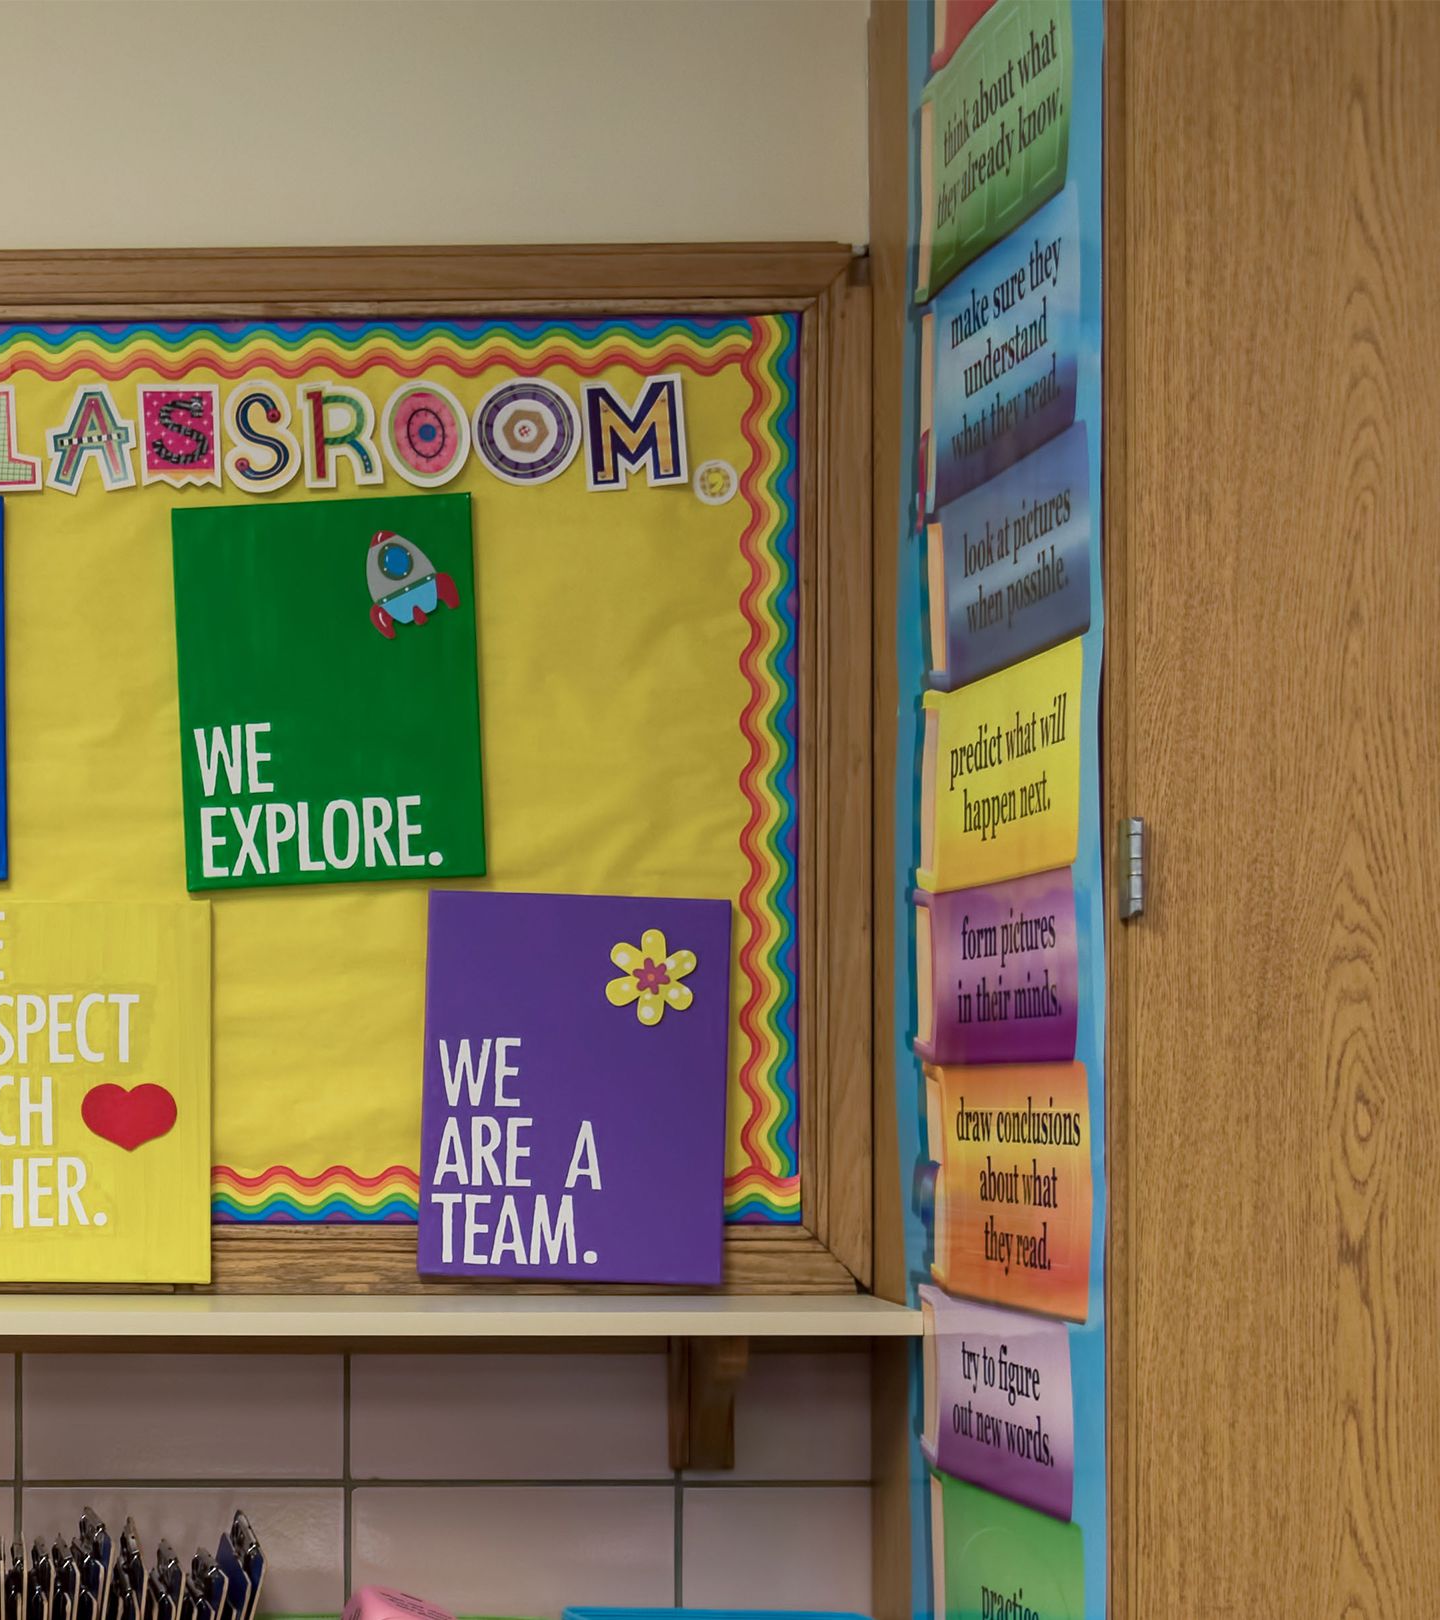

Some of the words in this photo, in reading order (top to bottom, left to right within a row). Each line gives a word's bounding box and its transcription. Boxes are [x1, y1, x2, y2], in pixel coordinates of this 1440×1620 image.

[943, 99, 970, 168] think
[972, 78, 1015, 132] about
[1018, 19, 1057, 88] what
[936, 180, 960, 229] they
[961, 121, 1015, 202] already
[1018, 86, 1063, 153] know.
[951, 288, 989, 350] make
[992, 267, 1025, 319] sure
[1029, 237, 1062, 291] they
[963, 295, 1048, 399] understand
[951, 414, 987, 462] what
[990, 391, 1020, 437] they
[1024, 352, 1060, 419] read.
[964, 521, 994, 578] look
[997, 517, 1010, 561] at
[1013, 489, 1071, 564] pictures
[966, 584, 1003, 633] when
[1007, 545, 1069, 629] possible.
[193, 721, 275, 796] WE
[949, 723, 1002, 791] predict
[1005, 710, 1036, 761] what
[1040, 692, 1067, 748] will
[199, 794, 444, 879] EXPLORE.
[963, 788, 1016, 841] happen
[1019, 769, 1051, 819] next.
[961, 915, 997, 960] form
[1000, 907, 1056, 968] pictures
[957, 979, 972, 1023] in
[976, 975, 1011, 1022] their
[1014, 968, 1062, 1019] minds.
[439, 1037, 521, 1107] WE
[433, 1116, 533, 1187] ARE
[564, 1120, 602, 1190] A
[955, 1096, 993, 1142] draw
[996, 1096, 1081, 1147] conclusions
[979, 1155, 1019, 1204] about
[1022, 1158, 1058, 1208] what
[431, 1193, 598, 1265] TEAM.
[984, 1215, 1013, 1276] they
[1016, 1221, 1051, 1270] read.
[961, 1341, 980, 1393] try
[982, 1346, 995, 1388] to
[998, 1344, 1041, 1406] figure
[953, 1400, 973, 1439] out
[976, 1411, 1002, 1449] new
[1004, 1415, 1054, 1468] words.
